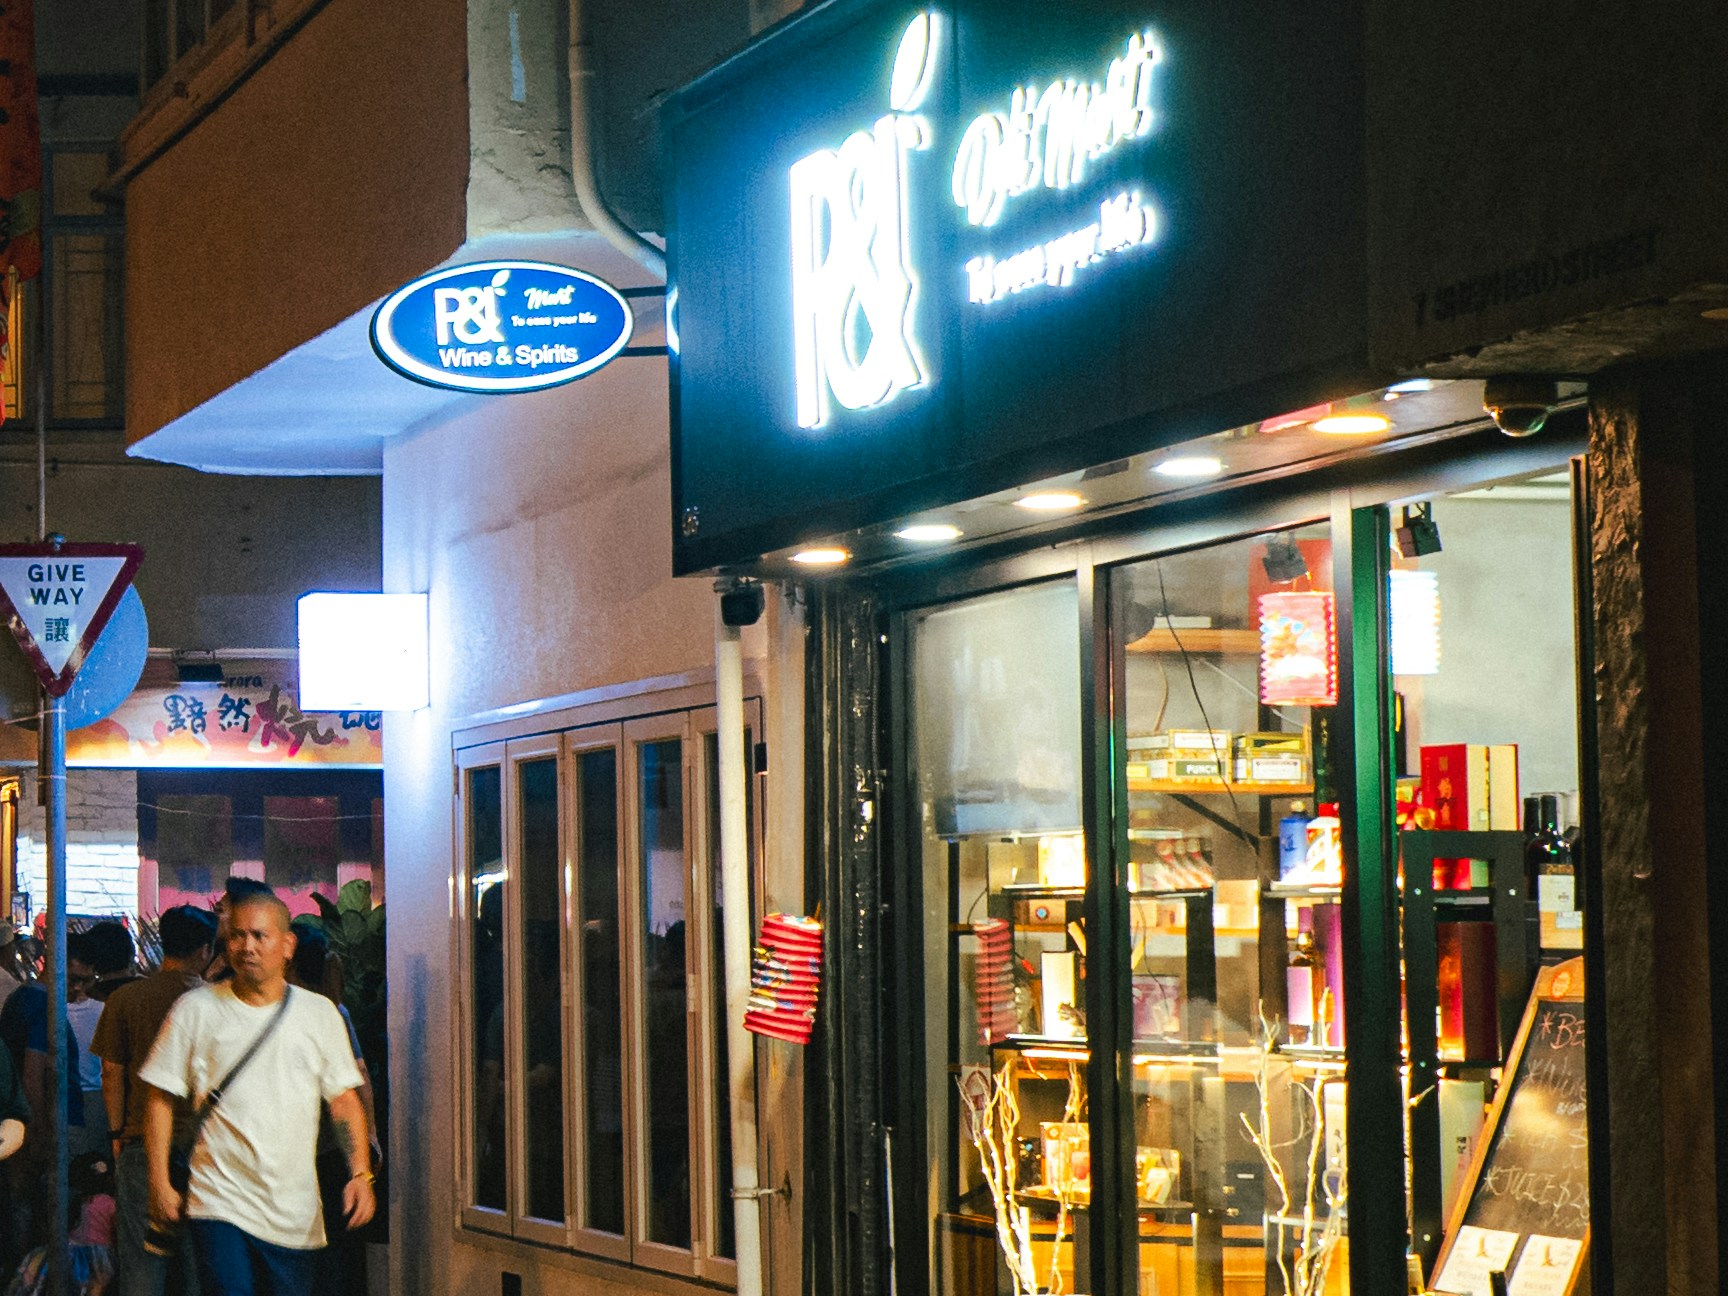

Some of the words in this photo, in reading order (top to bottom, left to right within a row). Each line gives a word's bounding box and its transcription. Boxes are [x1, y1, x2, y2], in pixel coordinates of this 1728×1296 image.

[438, 347, 489, 368] Wine
[495, 345, 513, 366] &
[515, 343, 579, 369] Spirits
[27, 563, 86, 583] GIVE
[29, 587, 85, 607] WAY
[44, 617, 71, 644] 讓
[217, 675, 263, 688] rora
